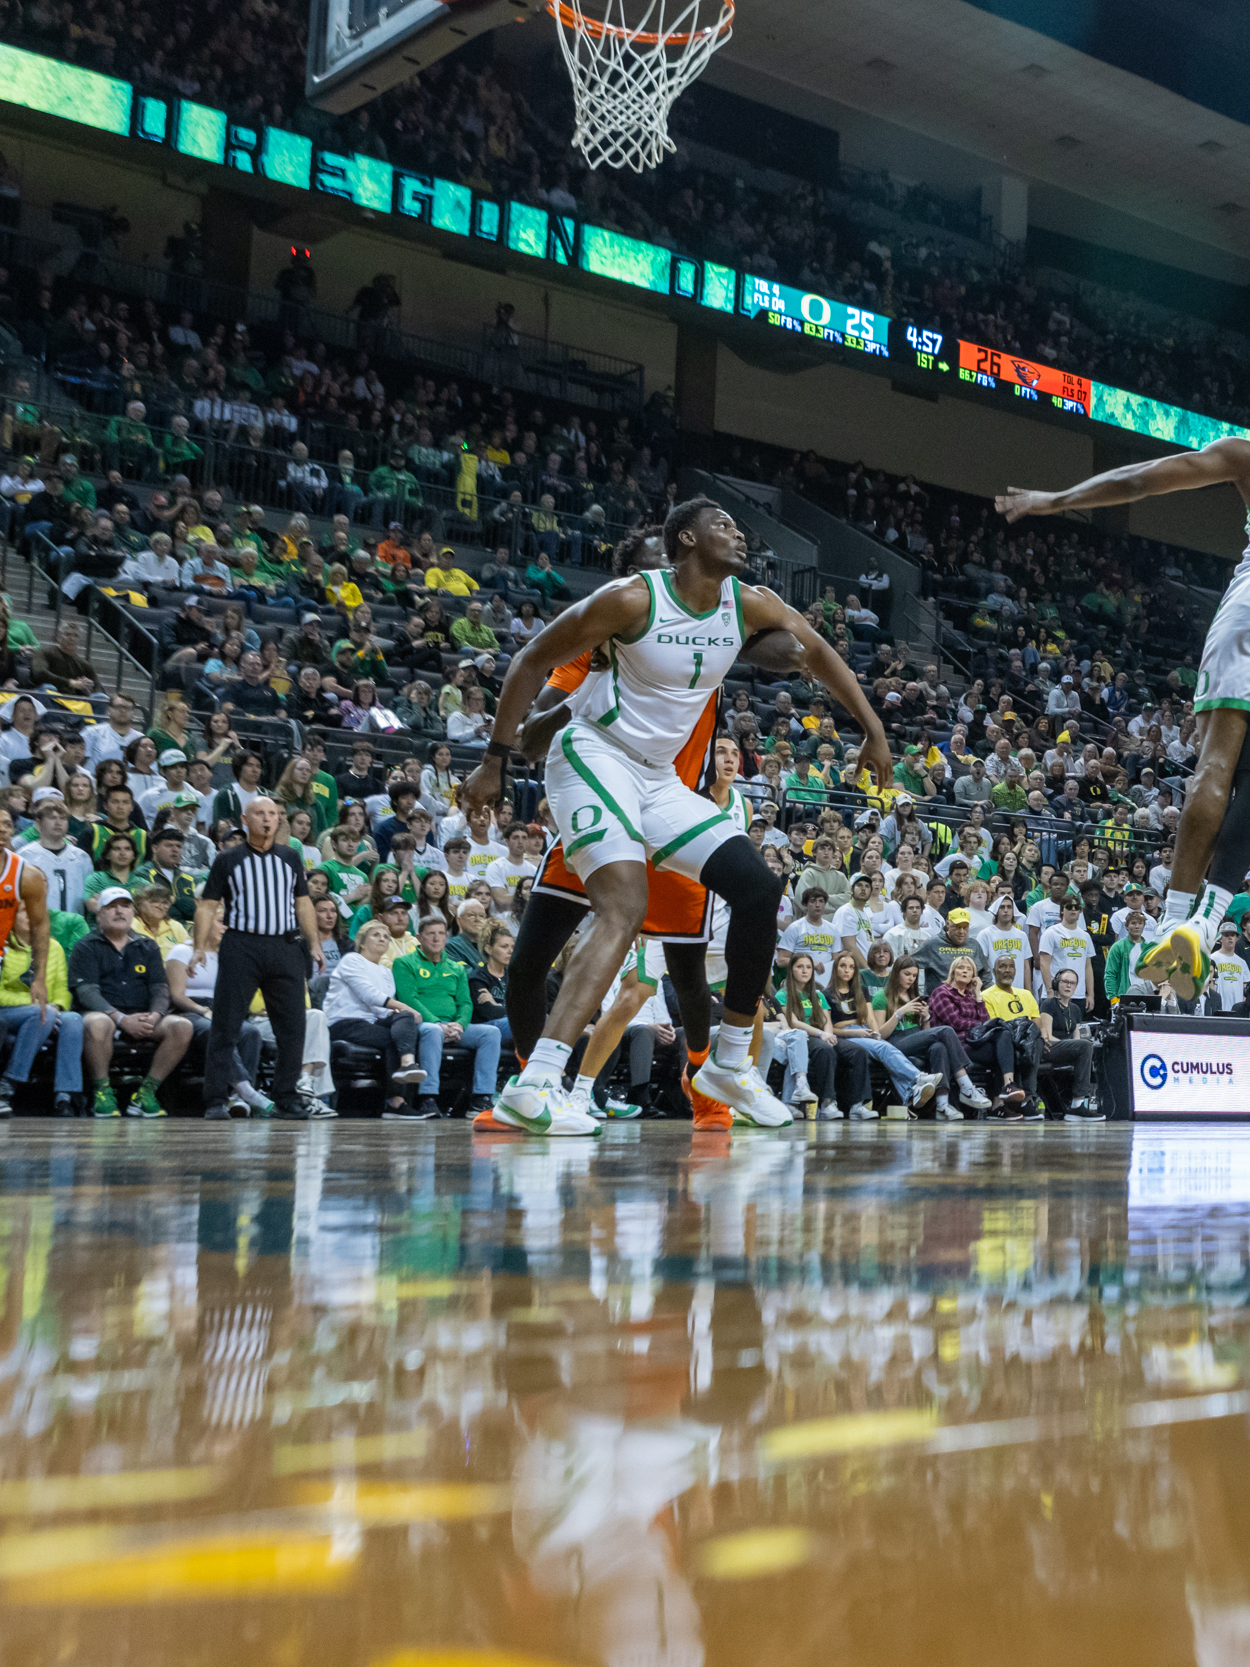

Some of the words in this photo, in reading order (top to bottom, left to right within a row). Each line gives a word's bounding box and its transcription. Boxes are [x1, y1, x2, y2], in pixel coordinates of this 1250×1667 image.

[772, 283, 780, 297] 4
[754, 292, 769, 307] FLS
[771, 297, 785, 312] 04
[846, 306, 875, 340] 25
[906, 325, 943, 355] 4:57
[916, 352, 934, 370] 1ST
[977, 348, 1001, 378] 26
[1062, 374, 1074, 386] TOL
[1077, 379, 1082, 388] 4
[959, 368, 976, 383] 66.7
[977, 373, 996, 389] FG%
[1014, 384, 1020, 396] 0
[1021, 386, 1038, 401] FT%
[1052, 396, 1063, 408] 40
[1063, 399, 1084, 415] 3PT%
[1062, 386, 1074, 397] FLS
[1077, 391, 1087, 402] 07
[657, 634, 734, 647] DUCKS
[688, 652, 704, 690] 1
[993, 938, 1022, 952] OREGON
[1060, 937, 1087, 949] OREGON
[1218, 962, 1242, 975] OREGON
[1171, 1061, 1233, 1075] CUMULUS
[1173, 1076, 1233, 1085] MEDIA
